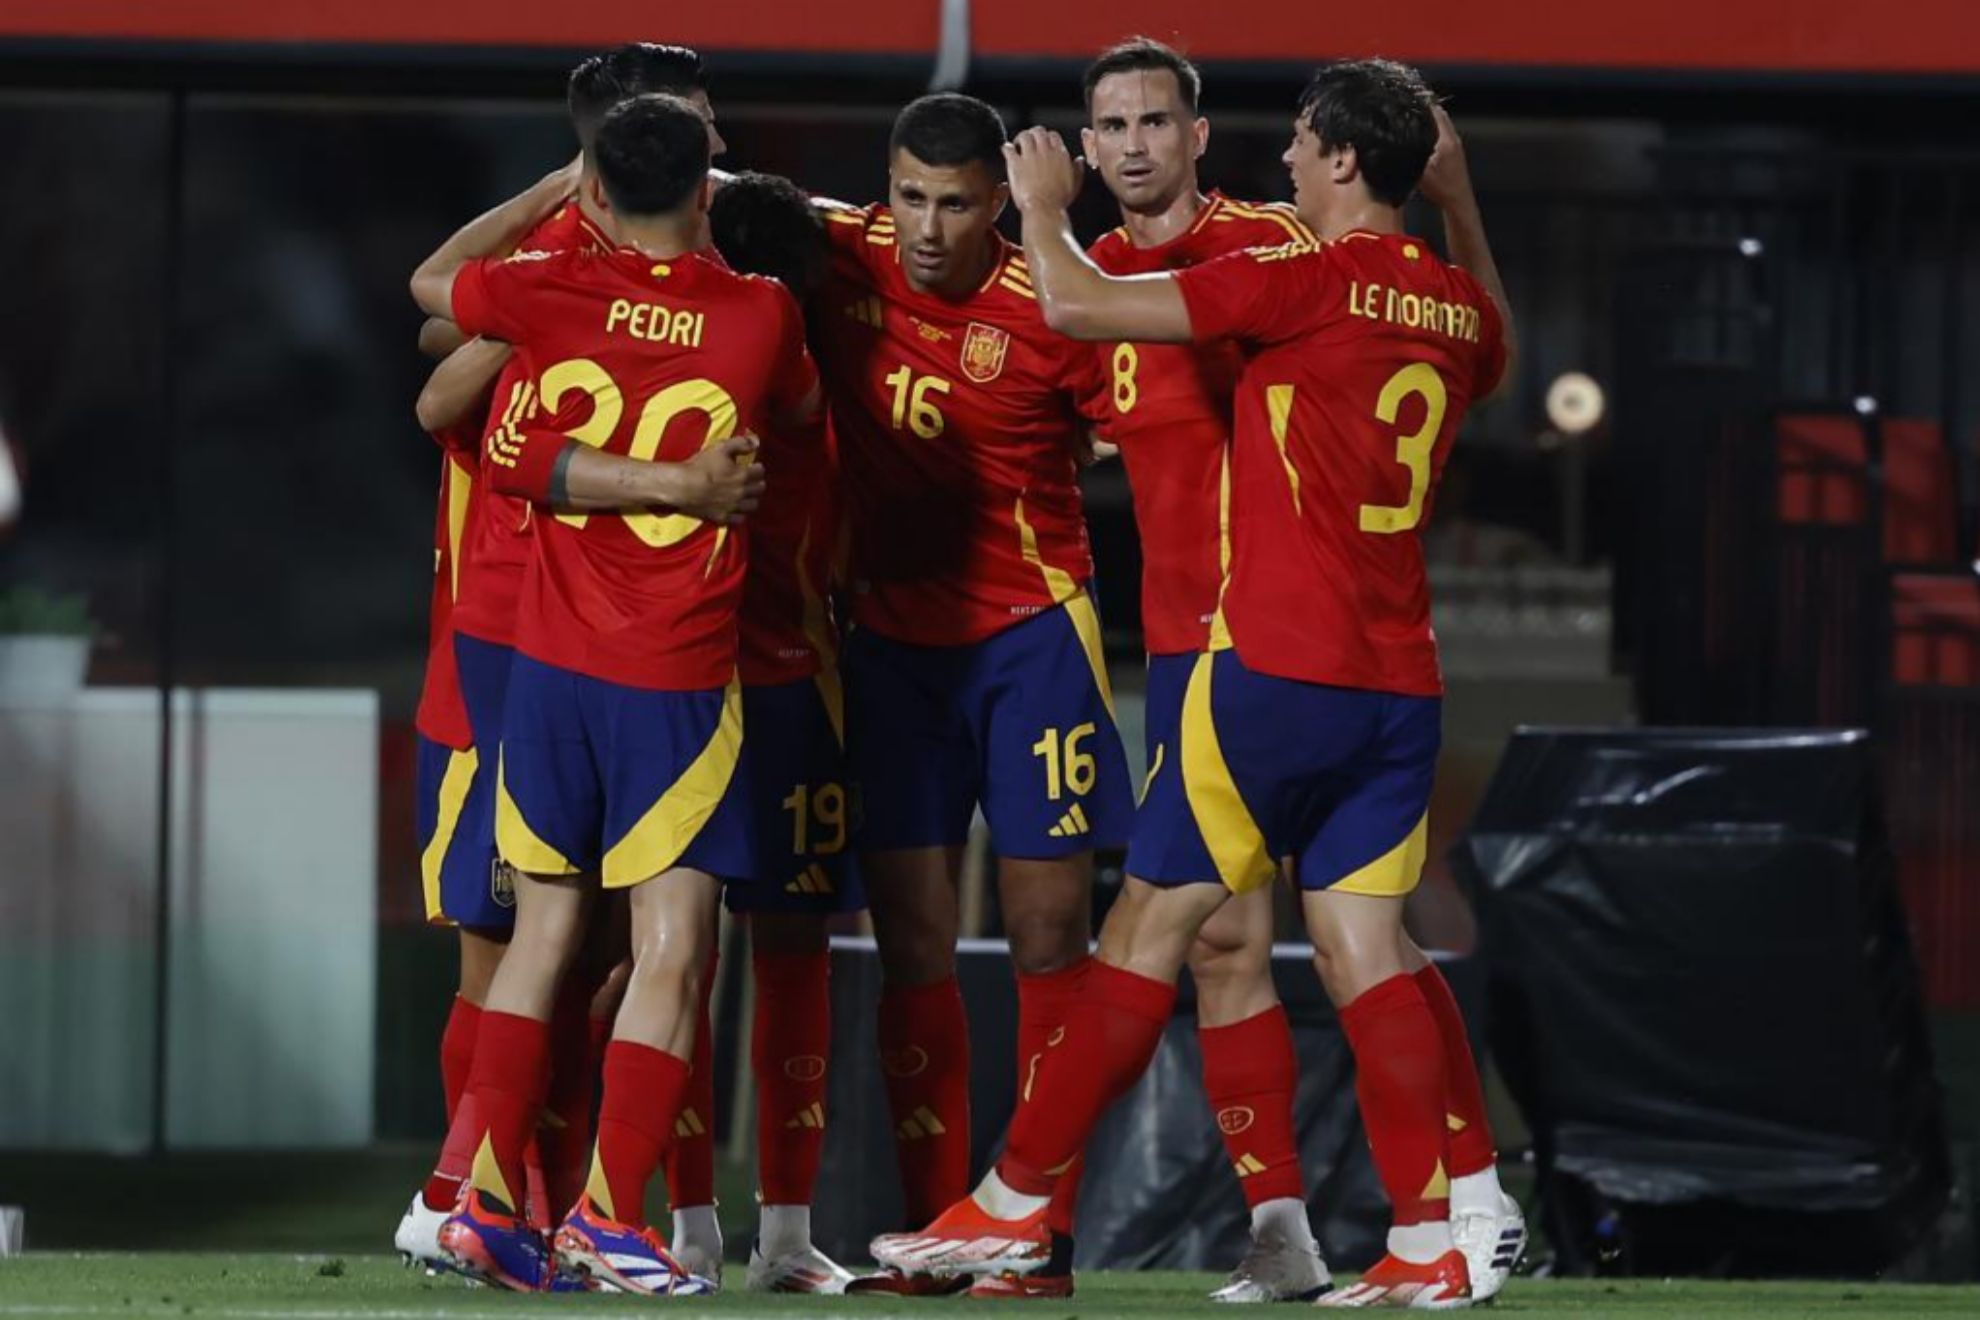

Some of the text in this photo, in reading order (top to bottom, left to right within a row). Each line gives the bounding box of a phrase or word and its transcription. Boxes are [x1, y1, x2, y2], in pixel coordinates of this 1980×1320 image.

[606, 299, 704, 347] PEDRI
[1350, 281, 1380, 319] LE
[885, 365, 950, 439] 16
[1113, 342, 1138, 413] 8
[1359, 362, 1447, 534] 3
[1033, 722, 1096, 800] 16
[783, 782, 846, 855] 19
